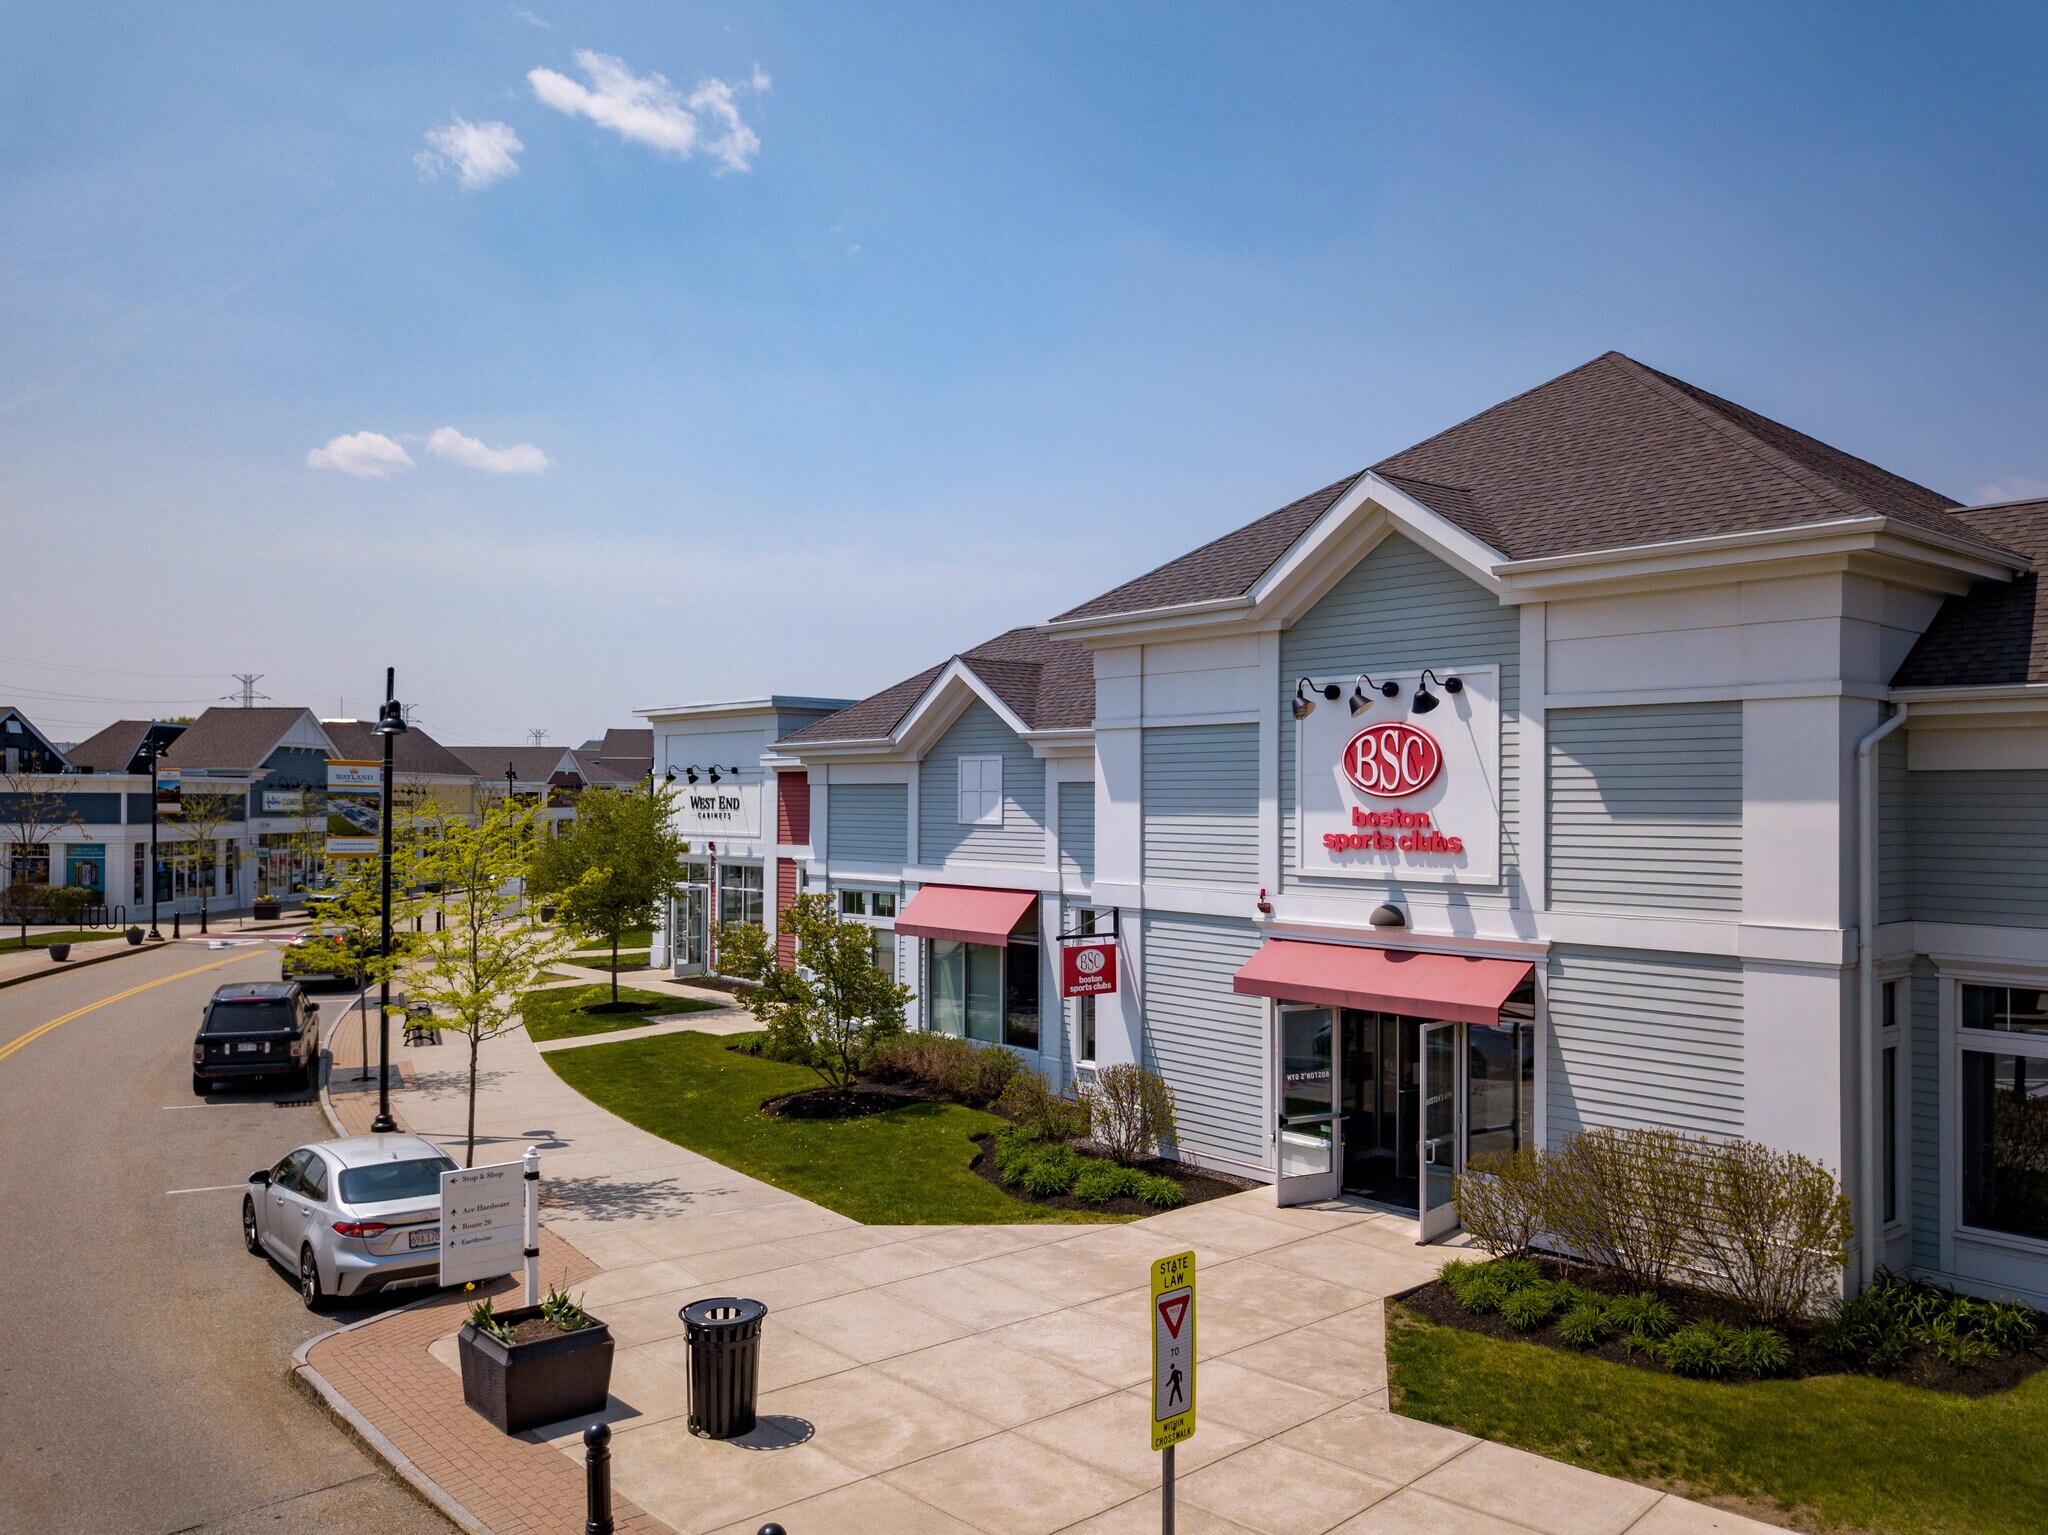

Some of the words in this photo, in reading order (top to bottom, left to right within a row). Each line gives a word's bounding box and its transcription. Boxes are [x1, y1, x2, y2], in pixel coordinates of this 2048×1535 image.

[1354, 729, 1424, 790] BSC
[335, 773, 374, 781] WAYLAND
[697, 812, 732, 820] CABINETS
[1352, 806, 1432, 828] boston
[1322, 830, 1395, 852] sports
[1397, 830, 1463, 853] clubs
[1081, 952, 1100, 970] BSC
[1070, 984, 1092, 993] sports
[1093, 982, 1111, 990] clubs
[462, 1175, 478, 1183] Stop
[479, 1172, 486, 1180] &
[486, 1170, 504, 1179] Shop
[462, 1206, 475, 1214] Ace
[476, 1201, 511, 1212] Hardware
[462, 1220, 482, 1230] Route
[461, 1234, 493, 1245] Earthwise
[1160, 1256, 1188, 1275] STATE
[1164, 1272, 1184, 1288] LAW
[1169, 1306, 1180, 1314] YIELD
[1170, 1347, 1180, 1357] TO
[1163, 1419, 1184, 1432] WITHIN
[1155, 1427, 1192, 1447] CROSSWALK
